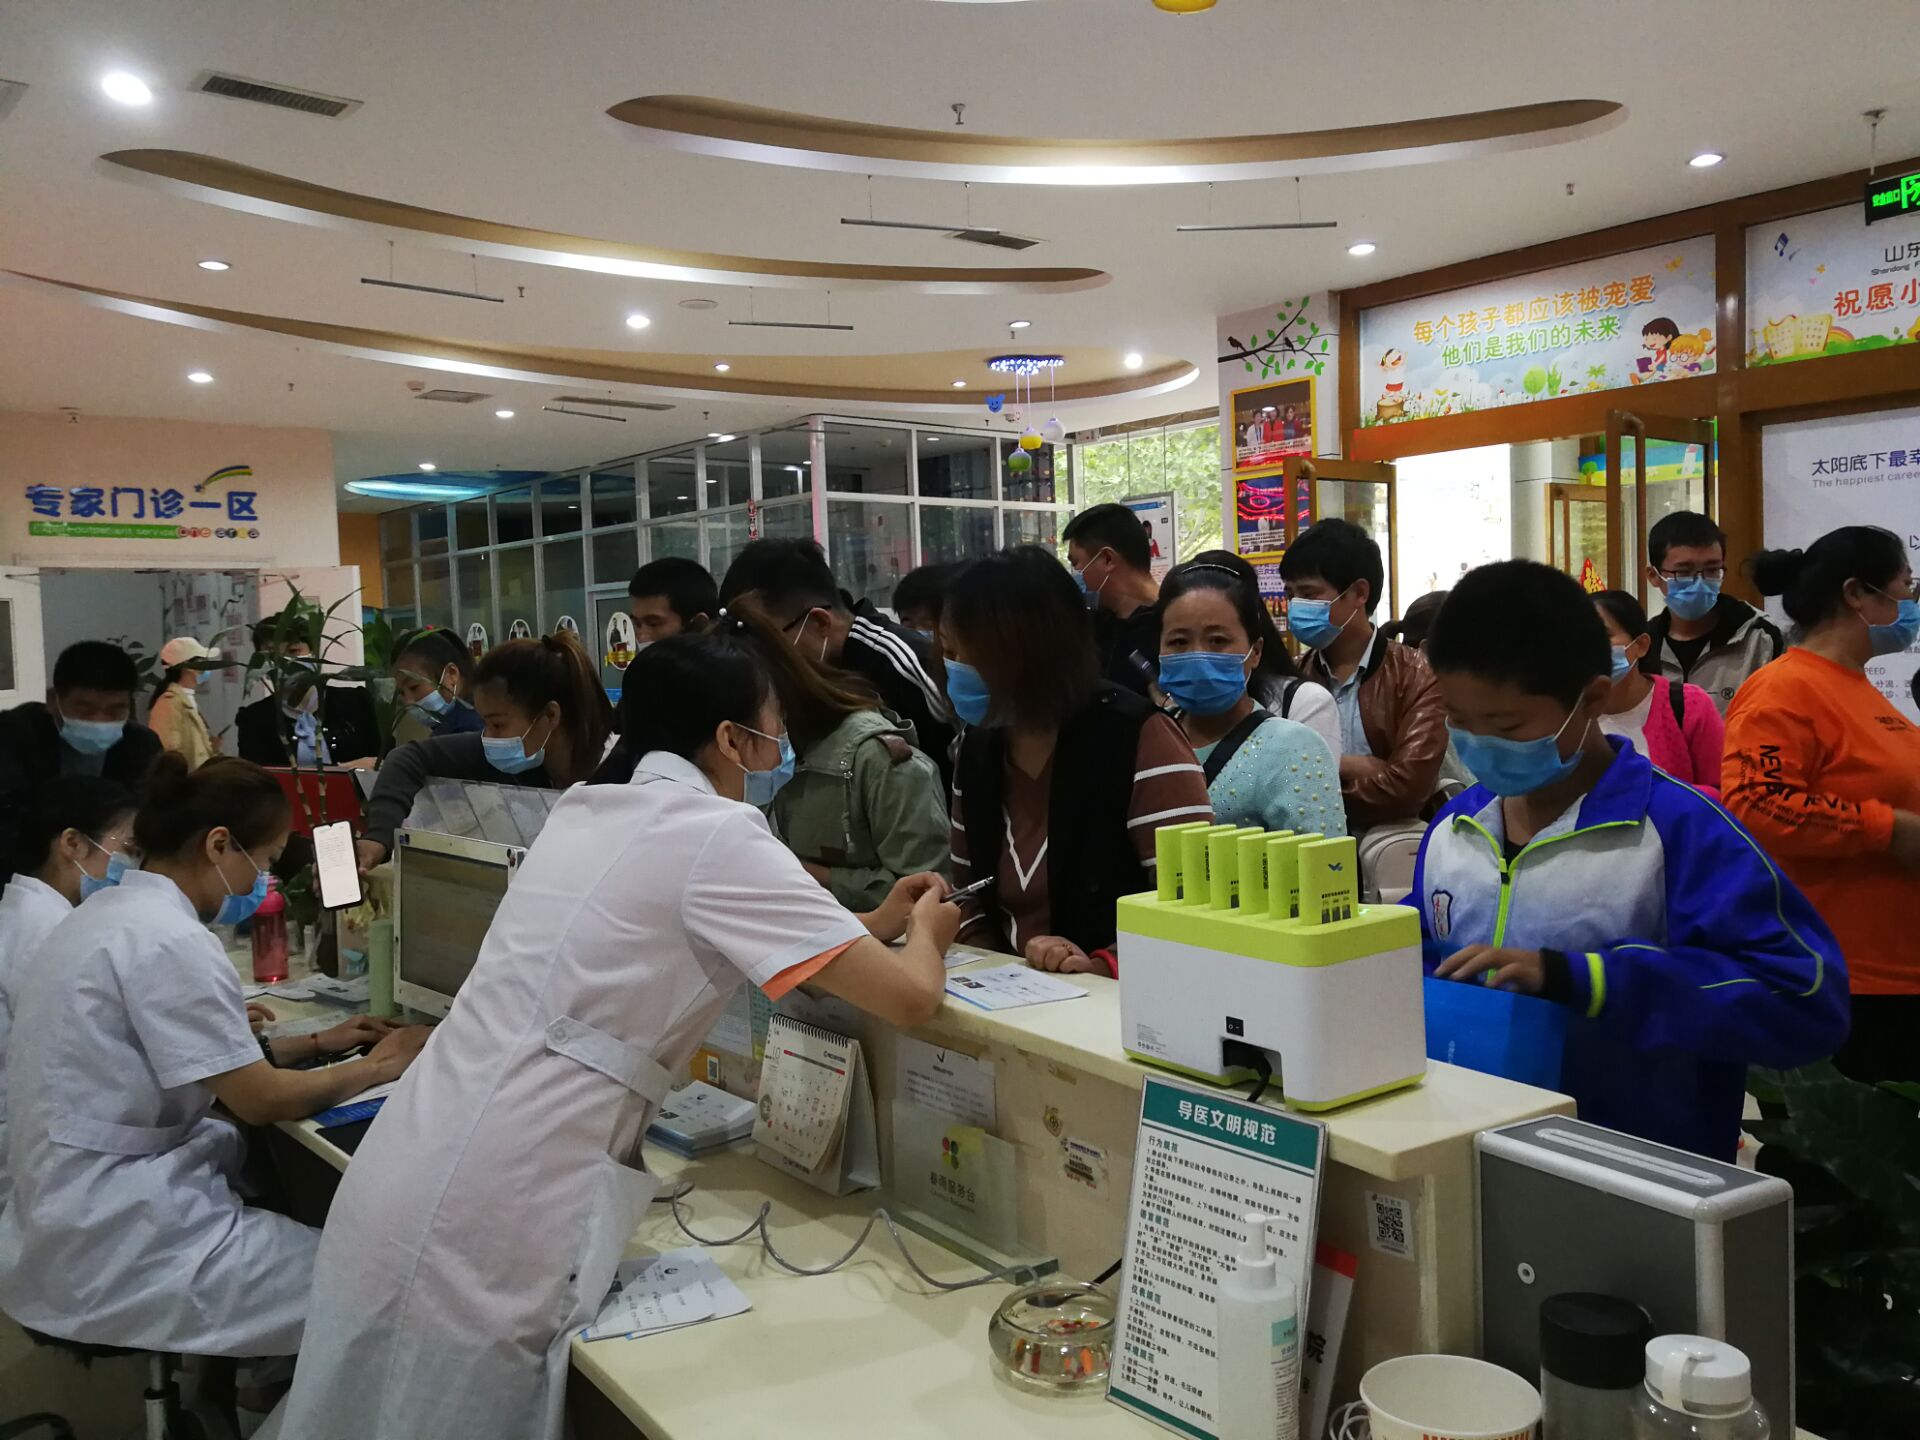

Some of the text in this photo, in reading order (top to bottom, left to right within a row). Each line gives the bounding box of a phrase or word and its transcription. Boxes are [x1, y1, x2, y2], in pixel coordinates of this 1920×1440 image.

[1413, 273, 1655, 345] 每个孩子都应该被宠爱
[1441, 315, 1621, 369] 他们是我们的未来
[26, 483, 258, 521] 专家门诊一区
[1813, 479, 1832, 488] The
[1835, 473, 1884, 487] happiest
[1177, 1100, 1277, 1146] 导医文明规范
